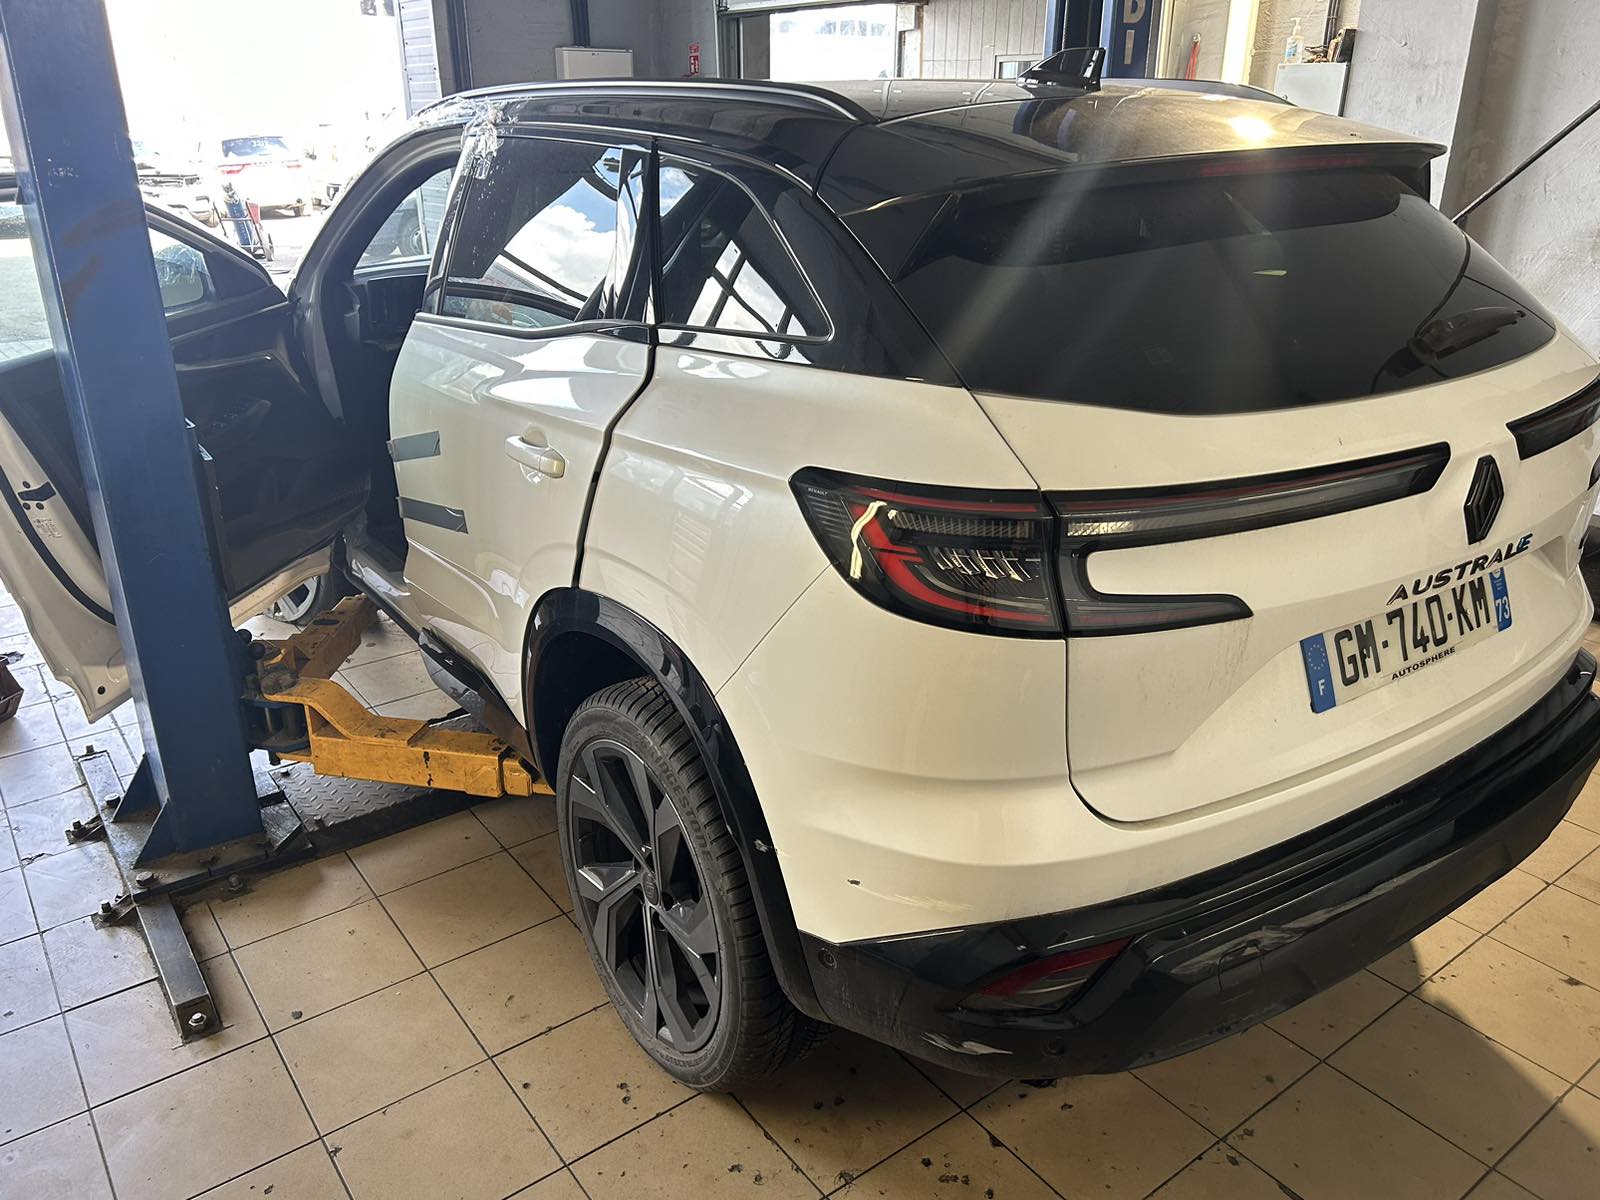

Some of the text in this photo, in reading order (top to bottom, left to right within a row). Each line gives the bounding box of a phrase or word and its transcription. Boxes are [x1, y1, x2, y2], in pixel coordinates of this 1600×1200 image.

[1386, 533, 1533, 605] AUSTRALE
[1334, 576, 1491, 686] GM-740-KM
[1495, 596, 1510, 622] 73
[1318, 679, 1326, 696] F
[1391, 646, 1456, 680] AUTOSPHERE
[638, 736, 713, 862] IDGESTONE
